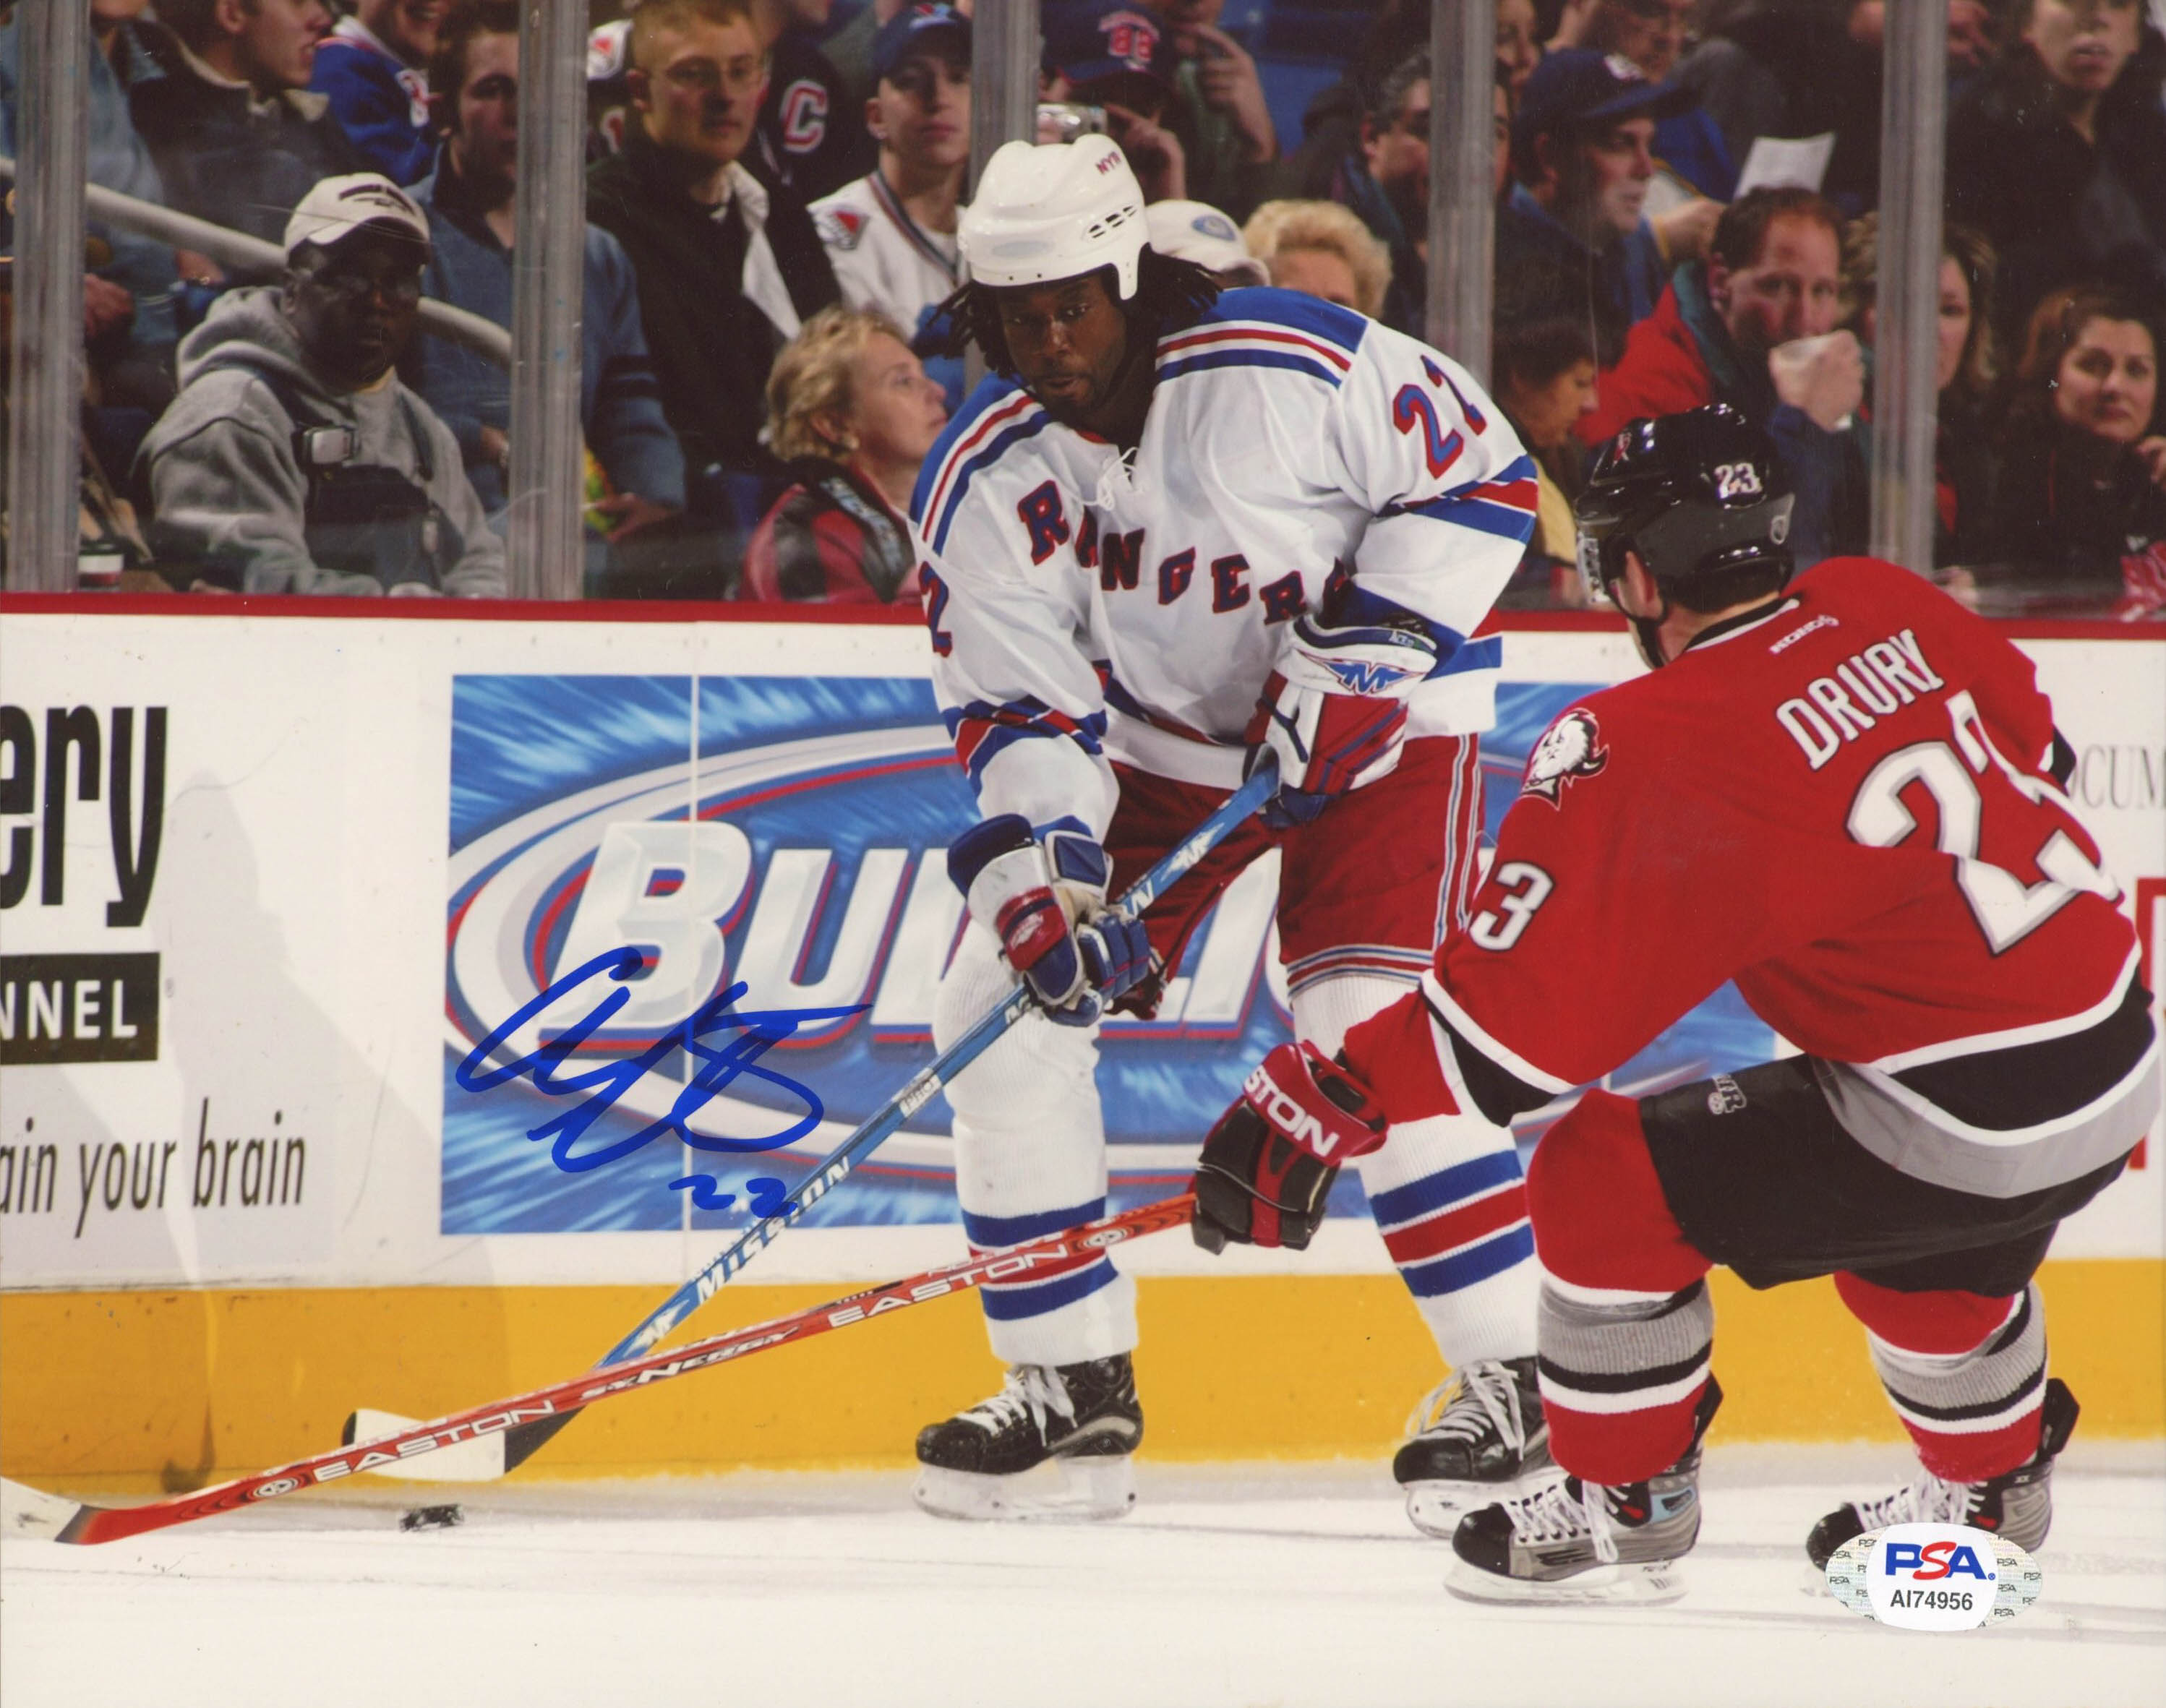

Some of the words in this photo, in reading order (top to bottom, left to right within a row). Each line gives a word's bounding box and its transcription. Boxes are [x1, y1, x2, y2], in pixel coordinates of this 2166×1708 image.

[779, 80, 828, 153] C
[1095, 150, 1121, 175] NYR
[1714, 463, 1763, 499] 23
[1775, 627, 1945, 773] DRURY
[2071, 743, 2166, 810] CUM
[1844, 688, 2126, 958] 23
[1468, 859, 1556, 951] 3
[1243, 1064, 1340, 1157] STON
[74, 1140, 178, 1239] your
[193, 1097, 306, 1208] brain
[829, 1244, 1069, 1329] EASTON
[314, 1399, 555, 1482] EASTON
